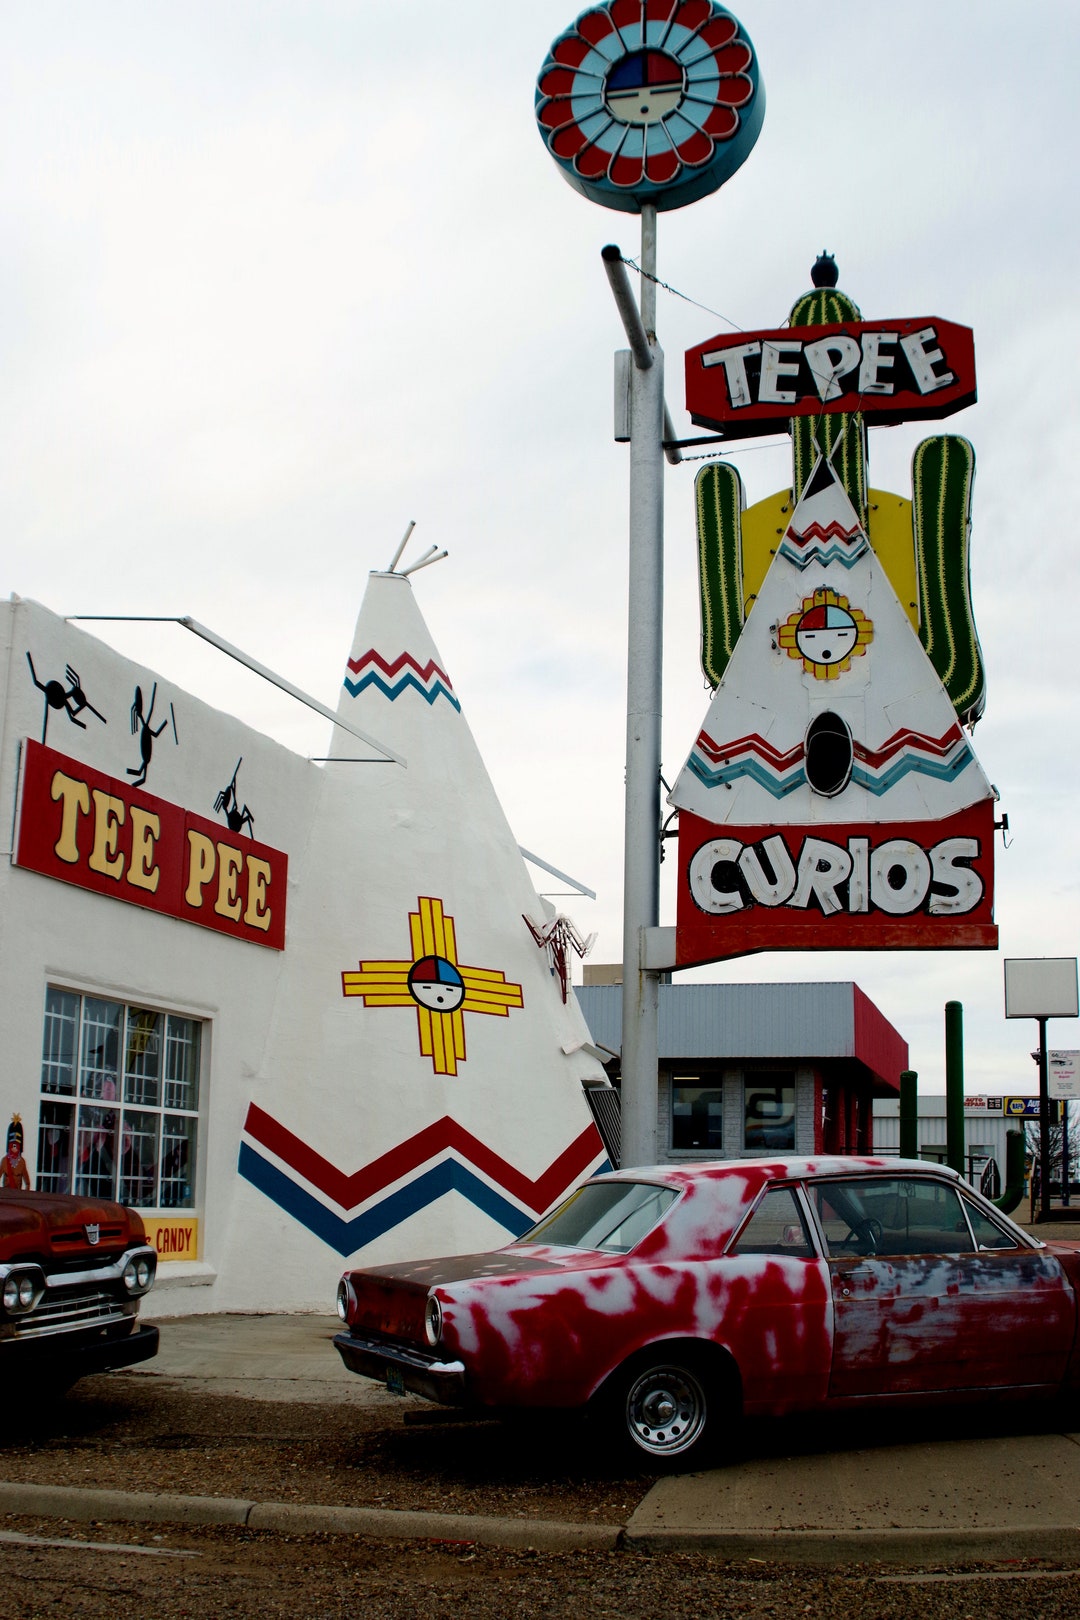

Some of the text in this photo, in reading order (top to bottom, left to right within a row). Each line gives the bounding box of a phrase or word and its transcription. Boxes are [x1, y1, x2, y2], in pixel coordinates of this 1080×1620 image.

[702, 327, 956, 409] TEPEE
[51, 770, 272, 931] TEE PEE
[688, 834, 984, 915] CURIOS
[156, 1228, 193, 1253] CANDY
